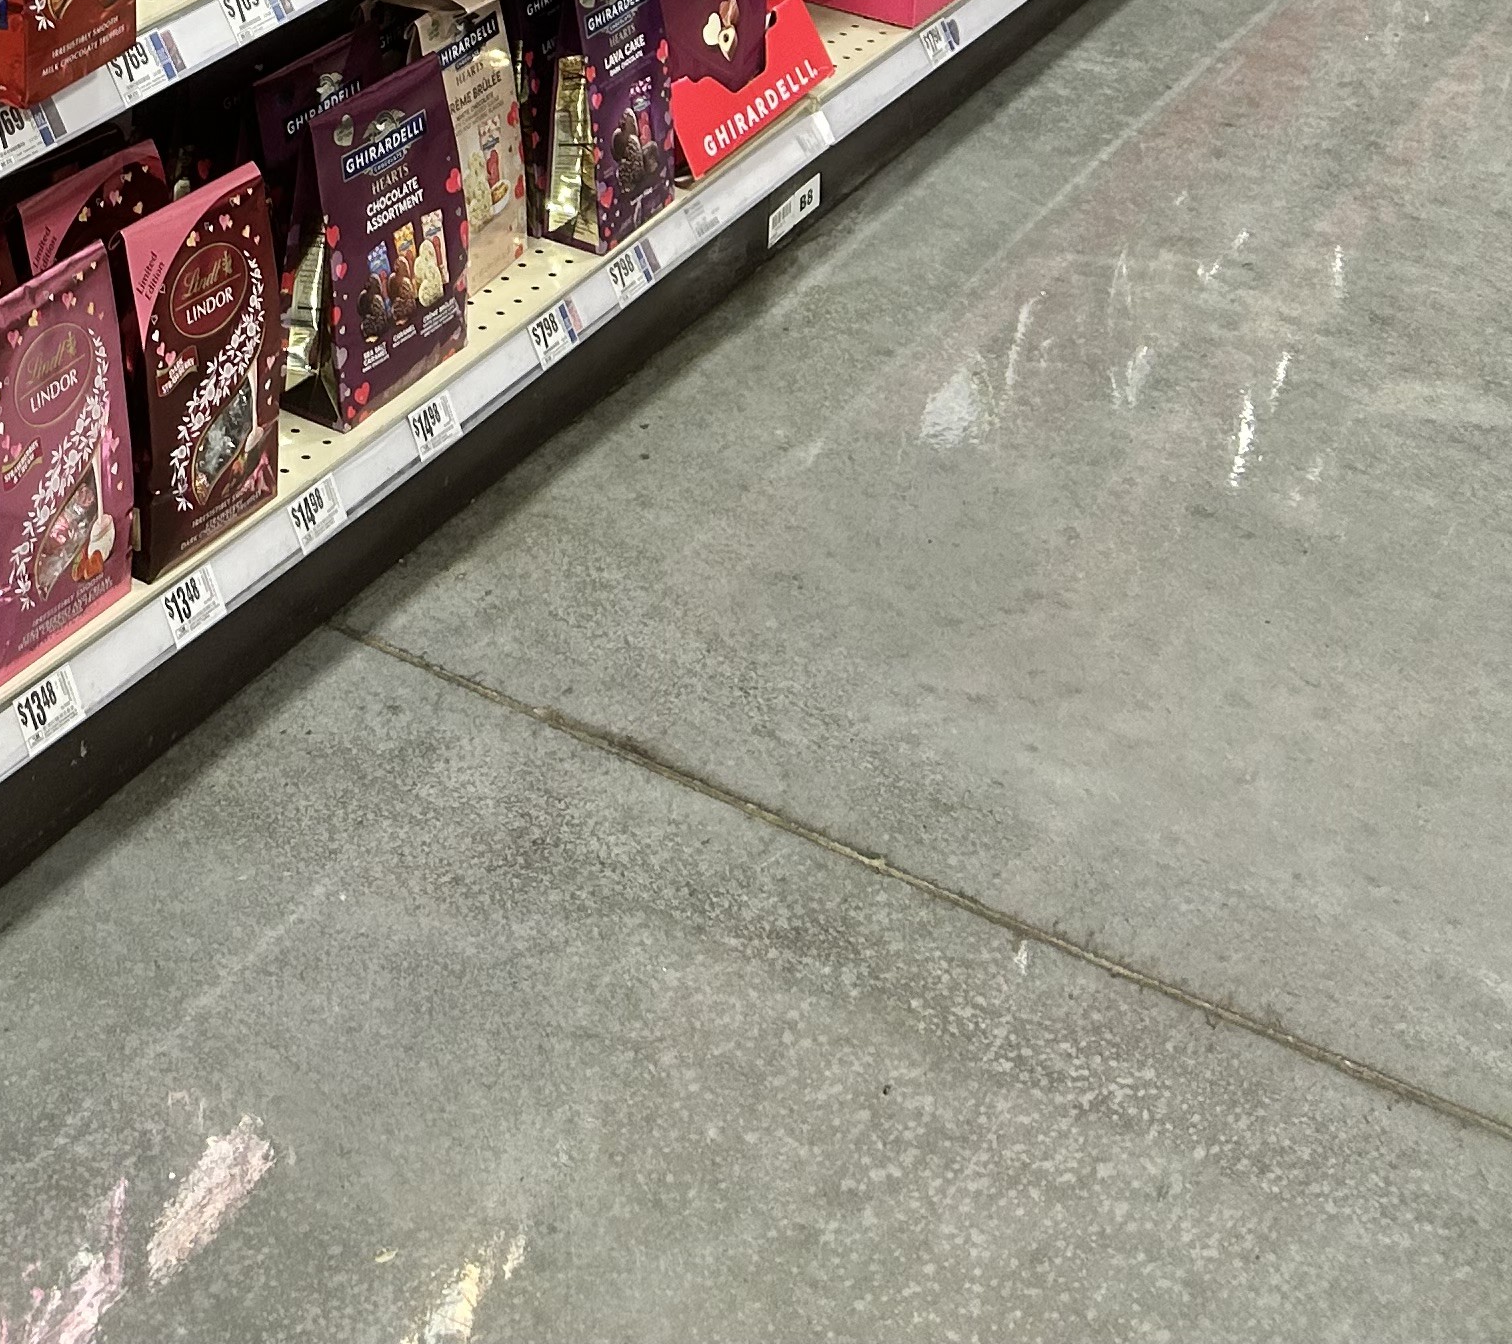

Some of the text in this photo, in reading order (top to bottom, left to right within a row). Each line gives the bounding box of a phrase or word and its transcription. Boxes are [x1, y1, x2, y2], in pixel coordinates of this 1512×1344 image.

[604, 34, 646, 70] LAVA CAKE
[472, 70, 502, 105] BRÛLÉE
[703, 60, 818, 156] GHIRARDELLI
[345, 117, 424, 174] GHIRARDELLI
[366, 177, 418, 216] CHOCOLATE
[371, 163, 409, 195] HEARTS
[366, 189, 424, 234] ASSORTMENT
[799, 187, 814, 212] B8
[136, 252, 158, 295] Limited
[144, 261, 166, 301] Edition
[186, 287, 233, 326] LINDOR
[29, 371, 78, 415] LINDOR
